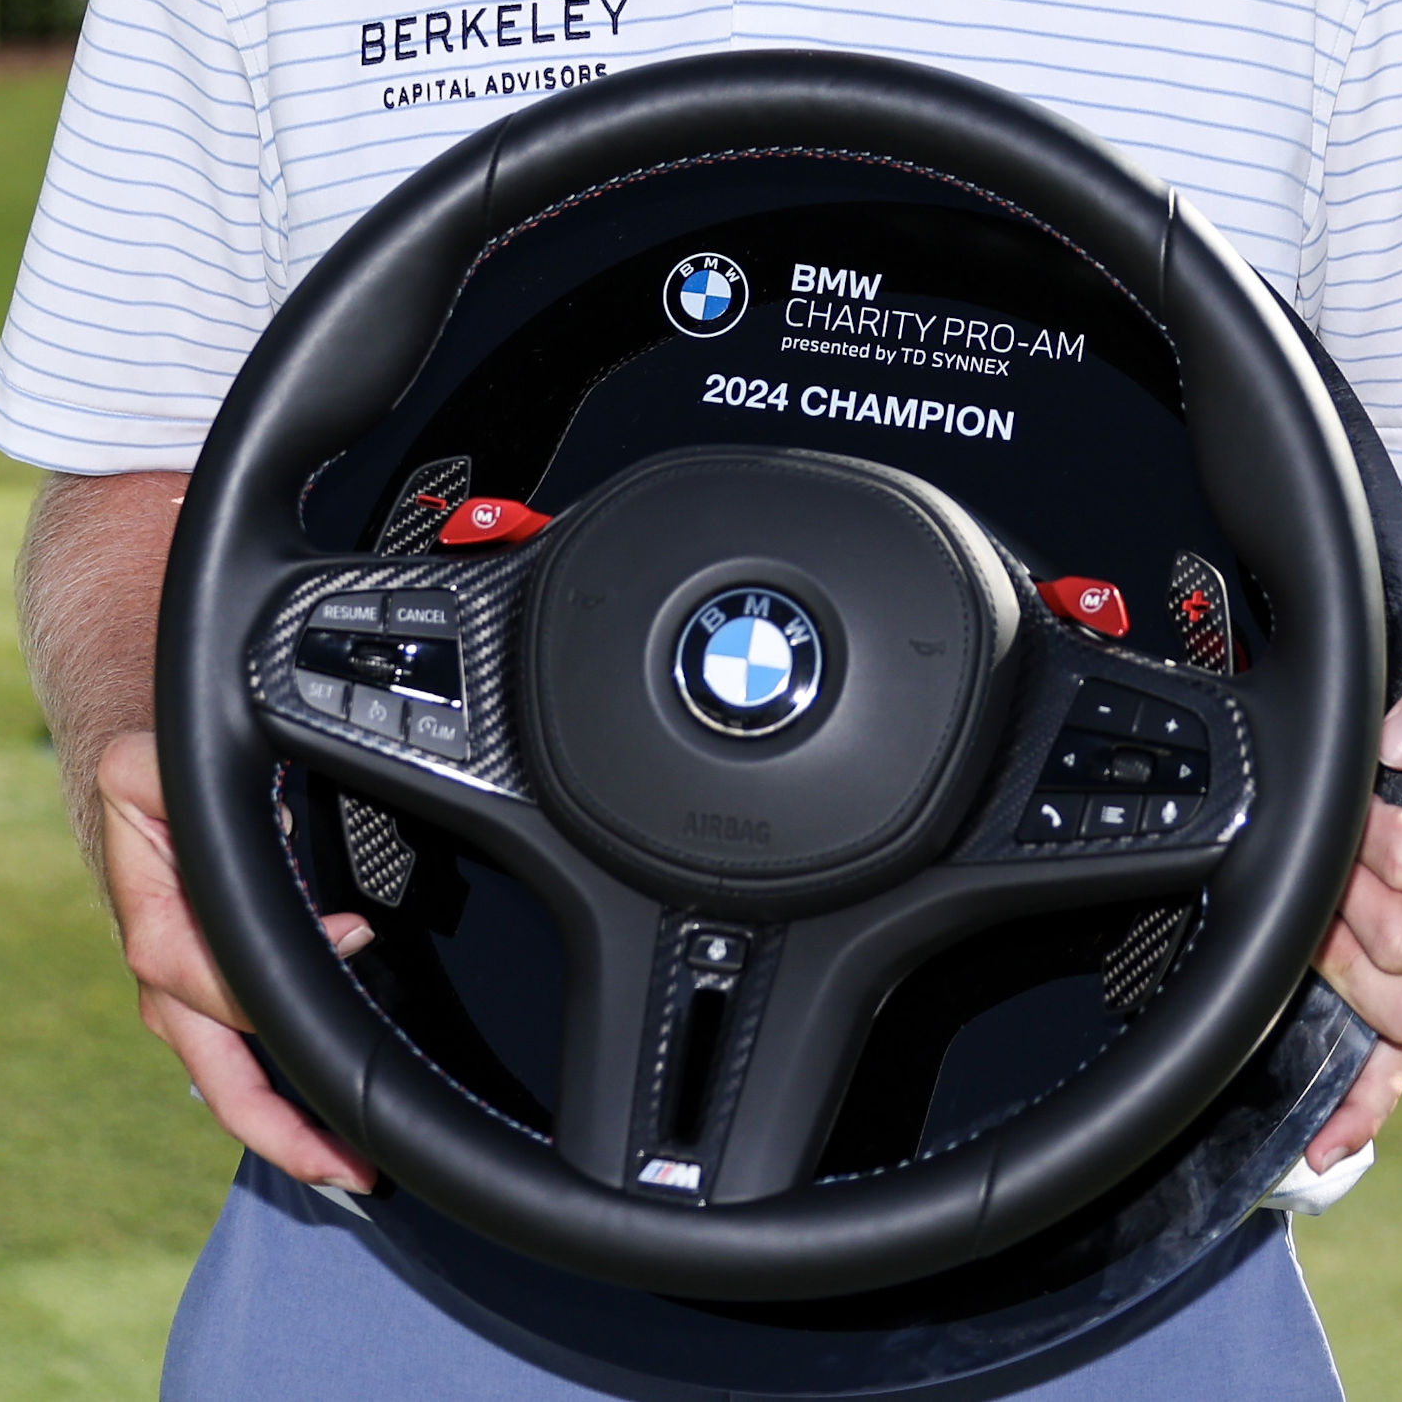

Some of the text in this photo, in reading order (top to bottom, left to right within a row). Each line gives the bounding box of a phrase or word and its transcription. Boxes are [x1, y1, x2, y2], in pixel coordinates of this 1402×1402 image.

[383, 77, 476, 110] CAPITAL
[678, 256, 741, 284] BMW
[791, 263, 883, 300] BMW
[785, 298, 1085, 363] CHARITY PRO-AM
[780, 335, 1010, 377] presented by TD SYNNEX
[702, 373, 1015, 441] 2024 CHAMPION
[323, 604, 378, 622] RESUME
[397, 607, 448, 625] CANCEL
[701, 594, 811, 647] BMW
[309, 681, 335, 699] SET
[683, 810, 770, 846] AIRBAG
